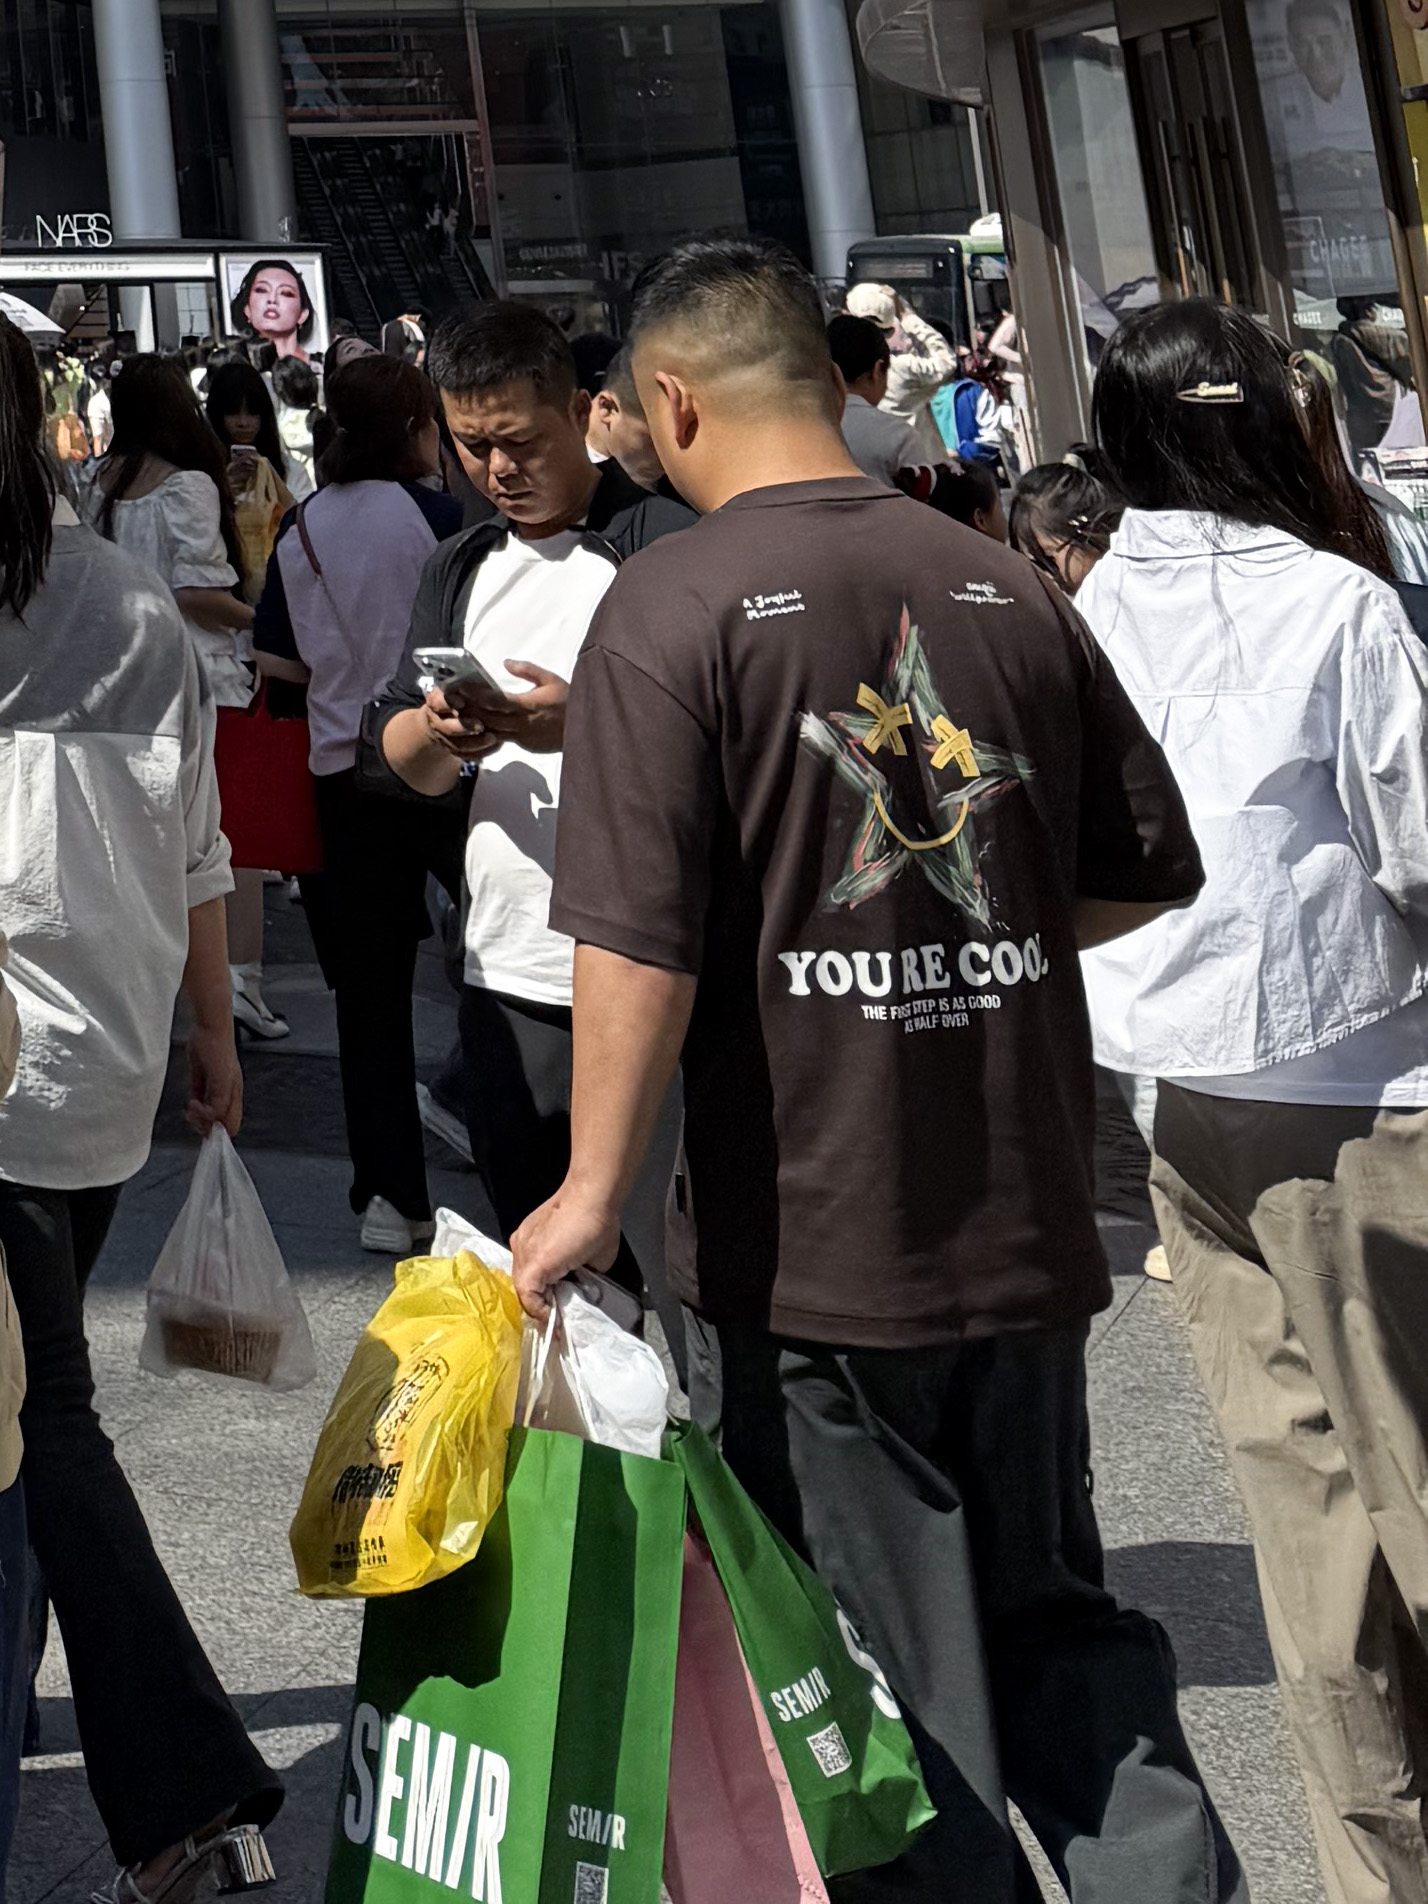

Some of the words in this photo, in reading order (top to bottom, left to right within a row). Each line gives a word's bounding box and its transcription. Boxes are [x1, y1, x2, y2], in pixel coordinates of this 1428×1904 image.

[36, 213, 113, 248] NARS
[861, 1004, 888, 1021] THE
[939, 997, 950, 1012] IS
[952, 996, 967, 1010] AS
[968, 995, 1002, 1009] GOOD
[941, 1013, 969, 1028] OVER
[344, 1702, 511, 1904] SEMIR
[567, 1804, 627, 1851] SEMIR
